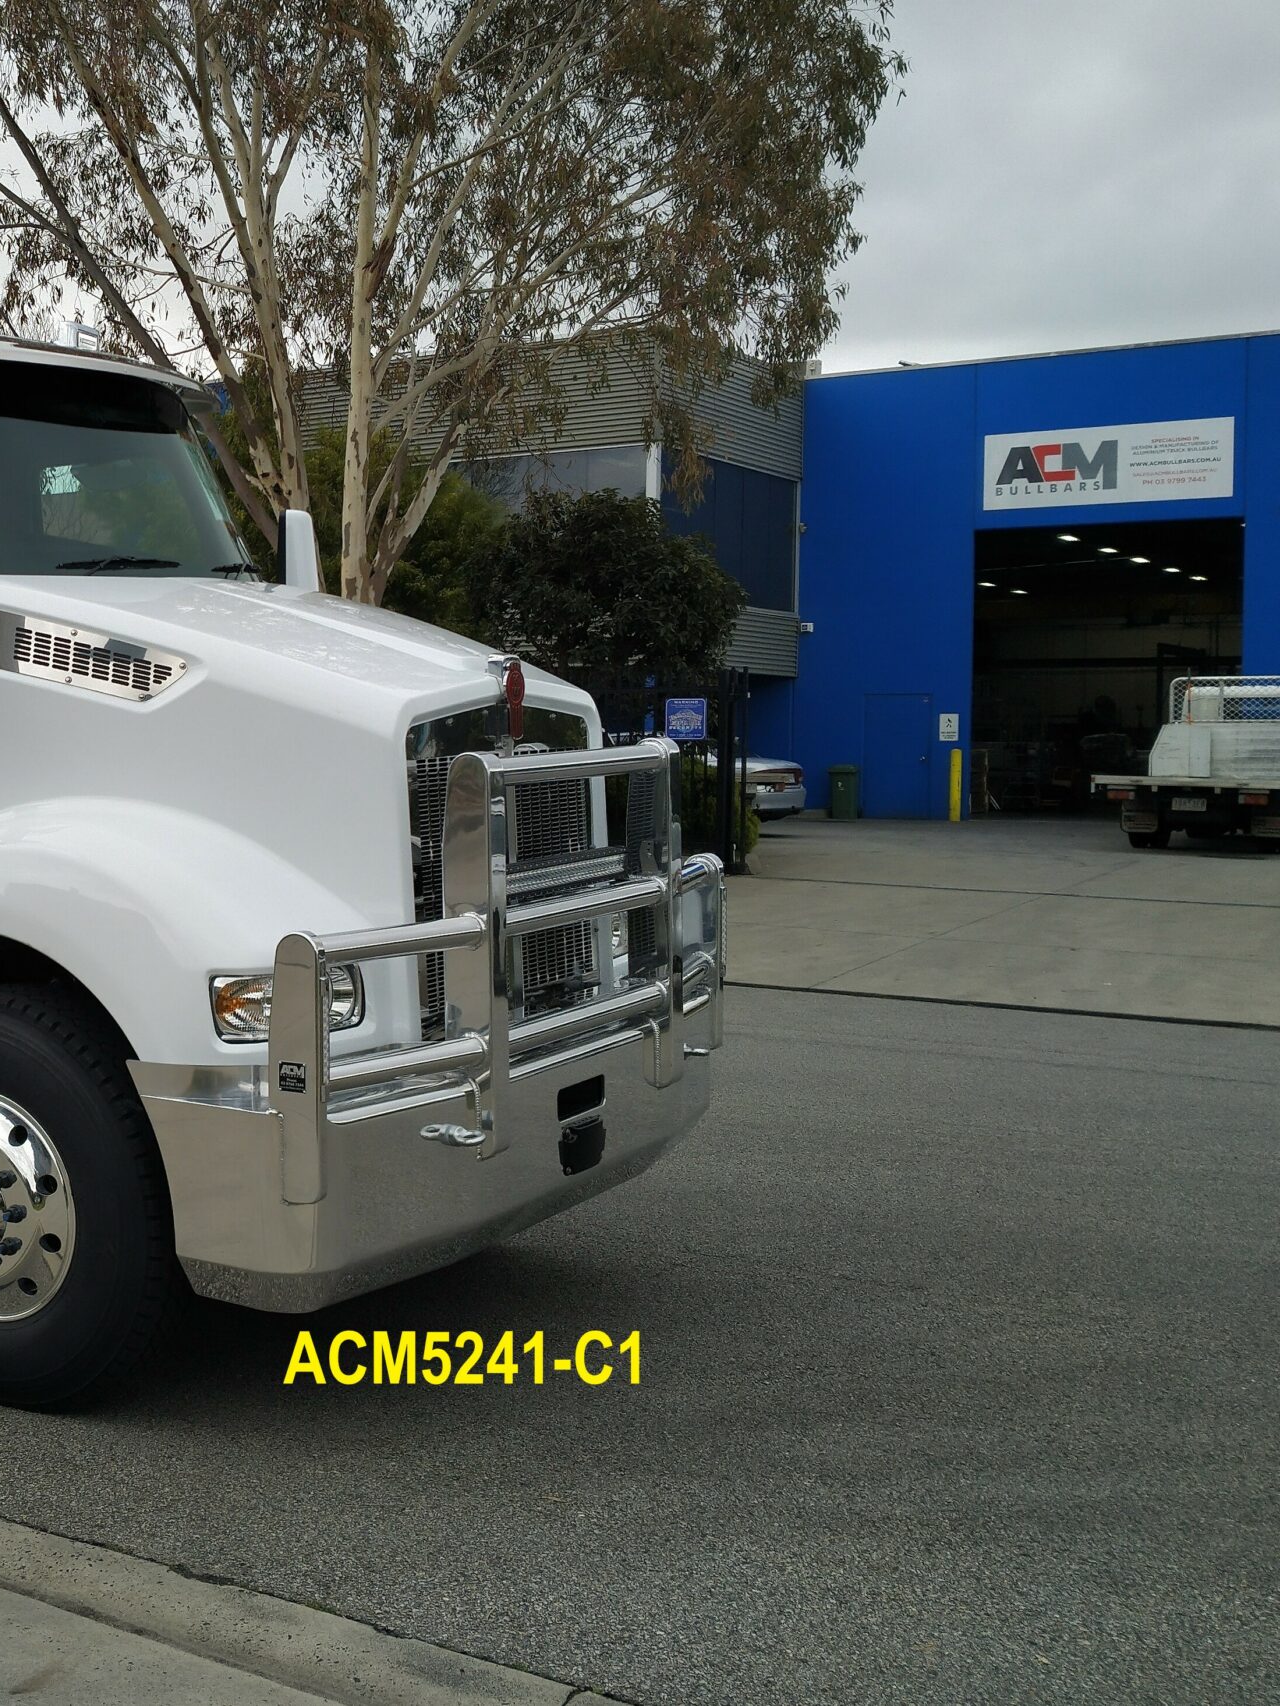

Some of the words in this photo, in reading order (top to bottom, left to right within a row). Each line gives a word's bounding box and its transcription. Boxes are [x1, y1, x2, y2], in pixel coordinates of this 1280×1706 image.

[995, 439, 1119, 490] ACM
[1129, 457, 1222, 468] WWW.ACMBULLBARS.COM.AU
[995, 480, 1101, 497] BULLBARS
[280, 1064, 305, 1079] ACM
